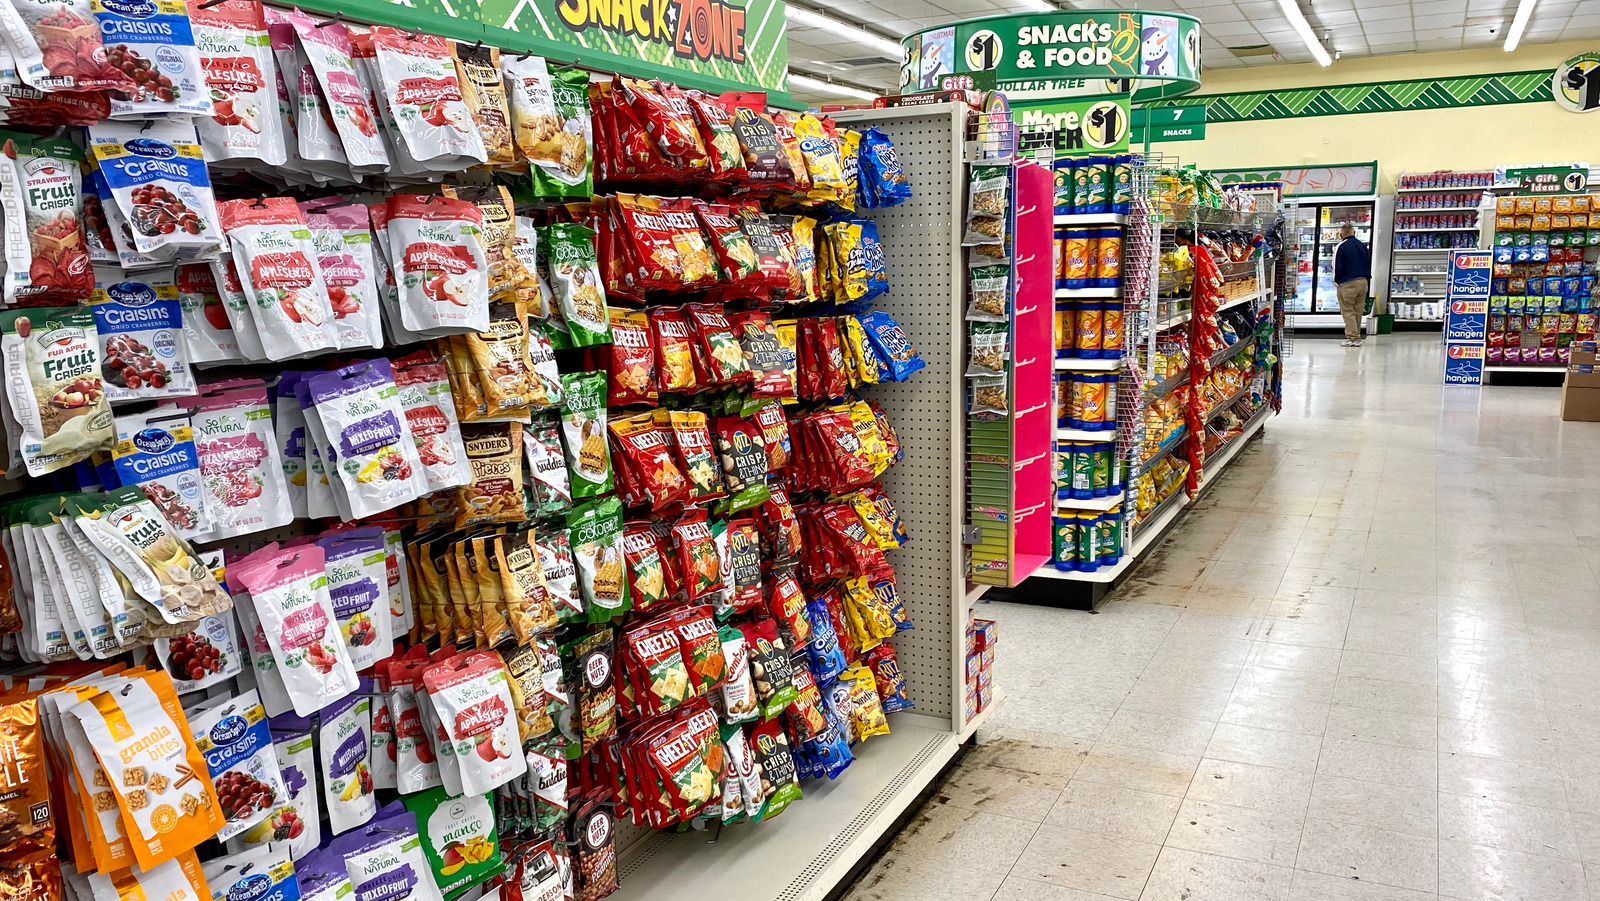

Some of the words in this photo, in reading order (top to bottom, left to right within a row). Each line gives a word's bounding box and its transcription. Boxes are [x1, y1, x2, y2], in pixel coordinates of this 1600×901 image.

[101, 19, 172, 35] Craisins
[674, 0, 744, 61] ZONE
[1152, 19, 1178, 28] CHRISTMAS
[1018, 23, 1112, 45] SNACKS
[1016, 52, 1035, 68] &
[1044, 46, 1113, 66] FOOD
[942, 76, 973, 91] Gift
[997, 80, 1047, 92] DOLLAR
[1050, 79, 1085, 88] TREE
[902, 94, 935, 102] CHOCOLATE
[1022, 108, 1079, 133] More
[1173, 110, 1183, 121] 7
[1163, 129, 1192, 137] SNACKS
[124, 160, 189, 176] Craisins
[27, 176, 72, 186] STRAWBERRY
[133, 174, 154, 182] DRIED
[1535, 174, 1558, 182] Gift
[29, 182, 75, 207] Fruit
[1531, 183, 1560, 192] Ideas
[40, 198, 74, 210] CRISPS
[746, 225, 771, 236] CRISP
[1460, 257, 1467, 265] 7
[1453, 285, 1488, 294] hangers
[1456, 302, 1462, 310] 7
[105, 307, 169, 324] Craisins
[1450, 330, 1483, 338] hangers
[47, 350, 64, 358] FUJI
[66, 342, 88, 352] APPLE
[751, 341, 775, 352] CRISP
[43, 348, 97, 378] Fruit
[55, 364, 92, 382] CRISPS
[1446, 374, 1479, 383] hangers
[200, 423, 244, 436] NATURAL
[206, 418, 218, 427] So
[468, 438, 508, 451] SNYDER'S
[133, 450, 188, 474] Craisins
[472, 460, 510, 477] Pieces
[736, 455, 761, 468] CRISP
[140, 472, 157, 480] DRIED
[158, 462, 189, 475] CRANBERRIES
[123, 516, 145, 532] BANANA
[126, 518, 162, 546] Fruit
[731, 534, 749, 550] RITZ
[732, 555, 757, 567] CRISP
[327, 570, 361, 585] NATURAL
[588, 658, 603, 669] BEER
[764, 657, 785, 673] CRISP
[591, 666, 605, 680] NUTS
[118, 725, 171, 764] granola
[147, 738, 180, 762] bites
[208, 733, 257, 768] Craisins
[763, 755, 788, 771] CRISP
[33, 807, 49, 820] 120
[442, 819, 482, 843] mango
[590, 817, 604, 833] BEER
[592, 828, 606, 843] NUTS
[364, 856, 400, 875] NATURAL
